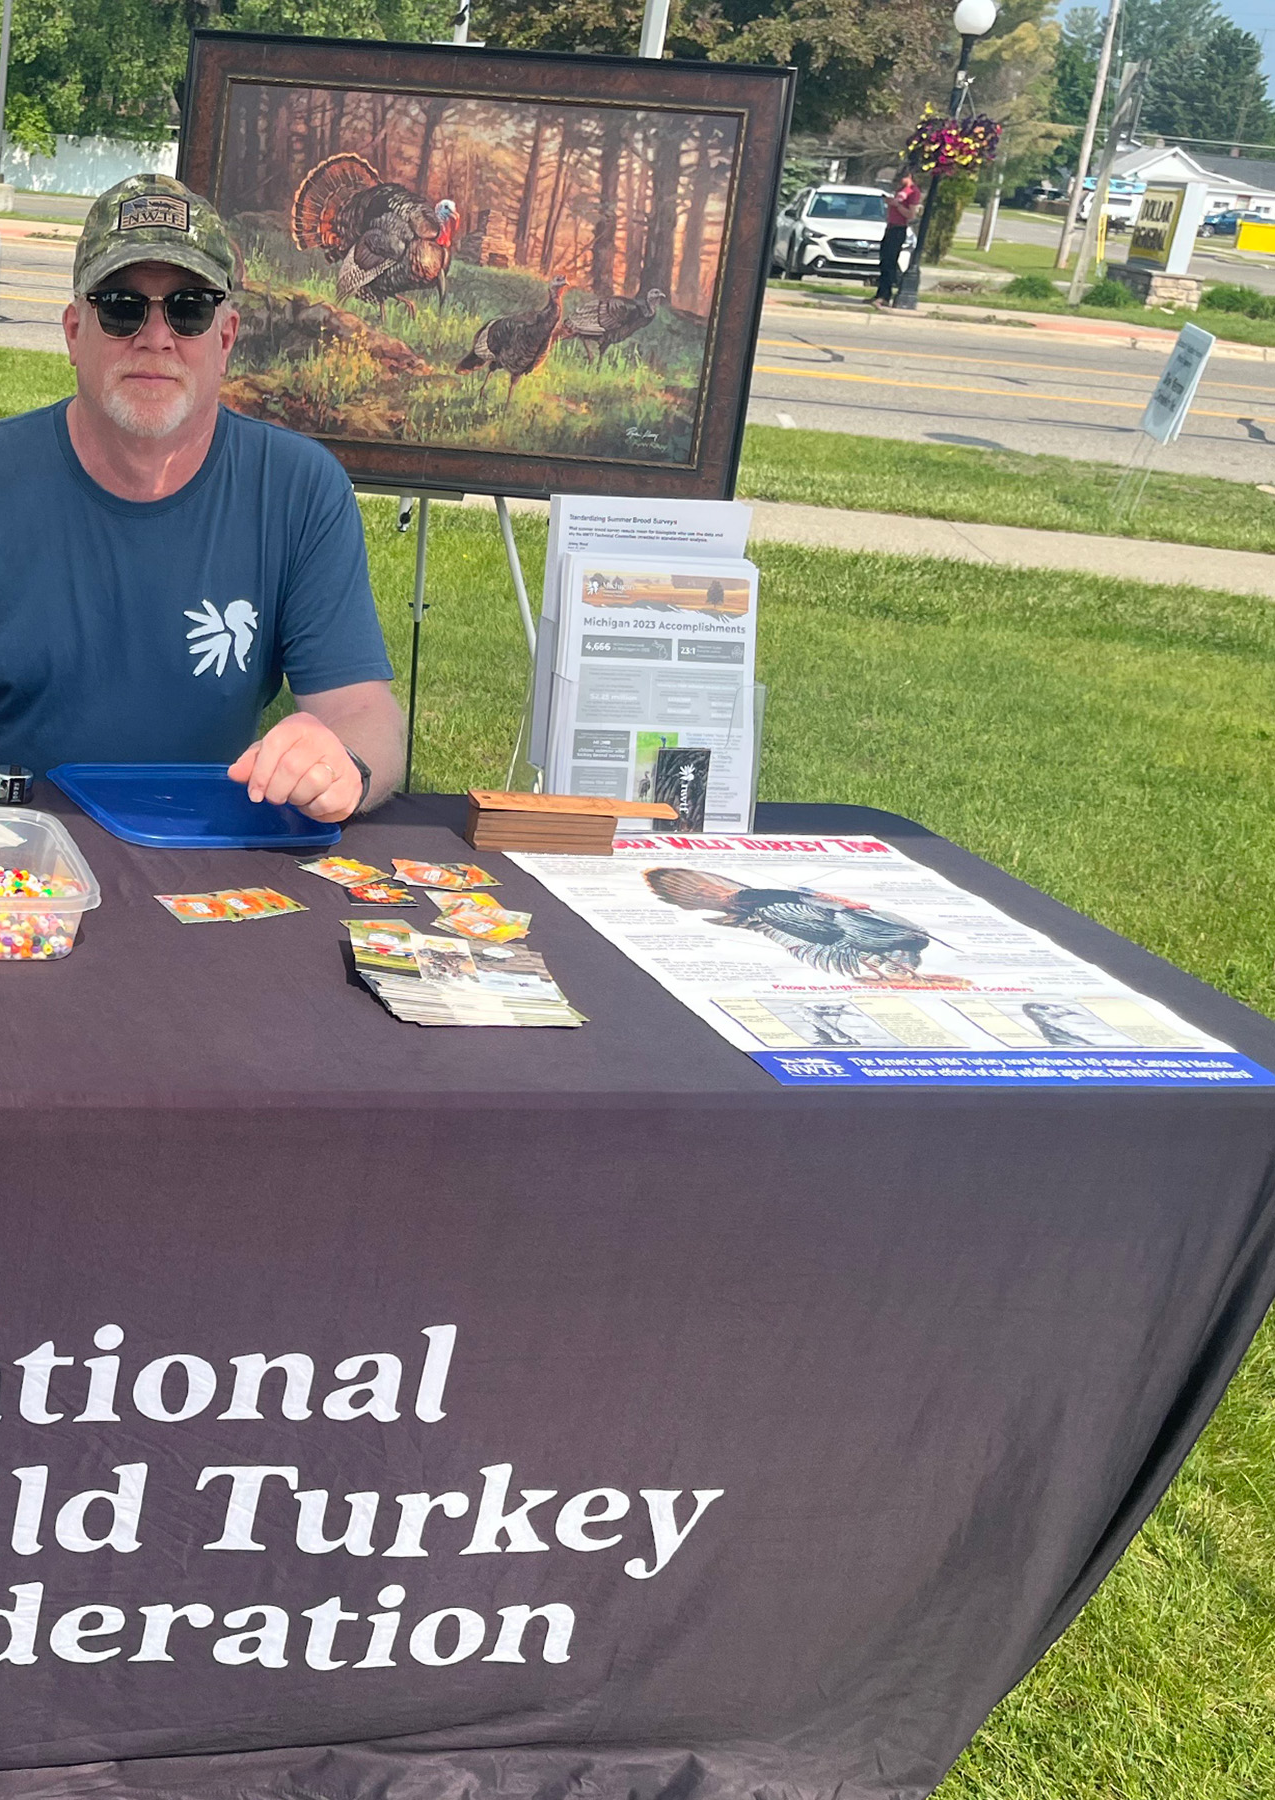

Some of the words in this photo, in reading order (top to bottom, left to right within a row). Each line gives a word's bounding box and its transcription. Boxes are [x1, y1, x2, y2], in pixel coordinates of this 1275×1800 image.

[653, 518, 677, 526] Surveys
[584, 617, 630, 629] Michigan
[633, 620, 656, 629] 2023
[659, 621, 746, 634] Accomplishments
[585, 642, 611, 651] 4,666
[847, 1057, 876, 1066] The
[874, 1057, 935, 1066] American
[957, 1057, 1006, 1068] Turkey
[860, 1067, 905, 1076] thanks
[901, 1068, 918, 1076] to
[915, 1068, 939, 1076] the
[196, 1463, 724, 1579] Turkey
